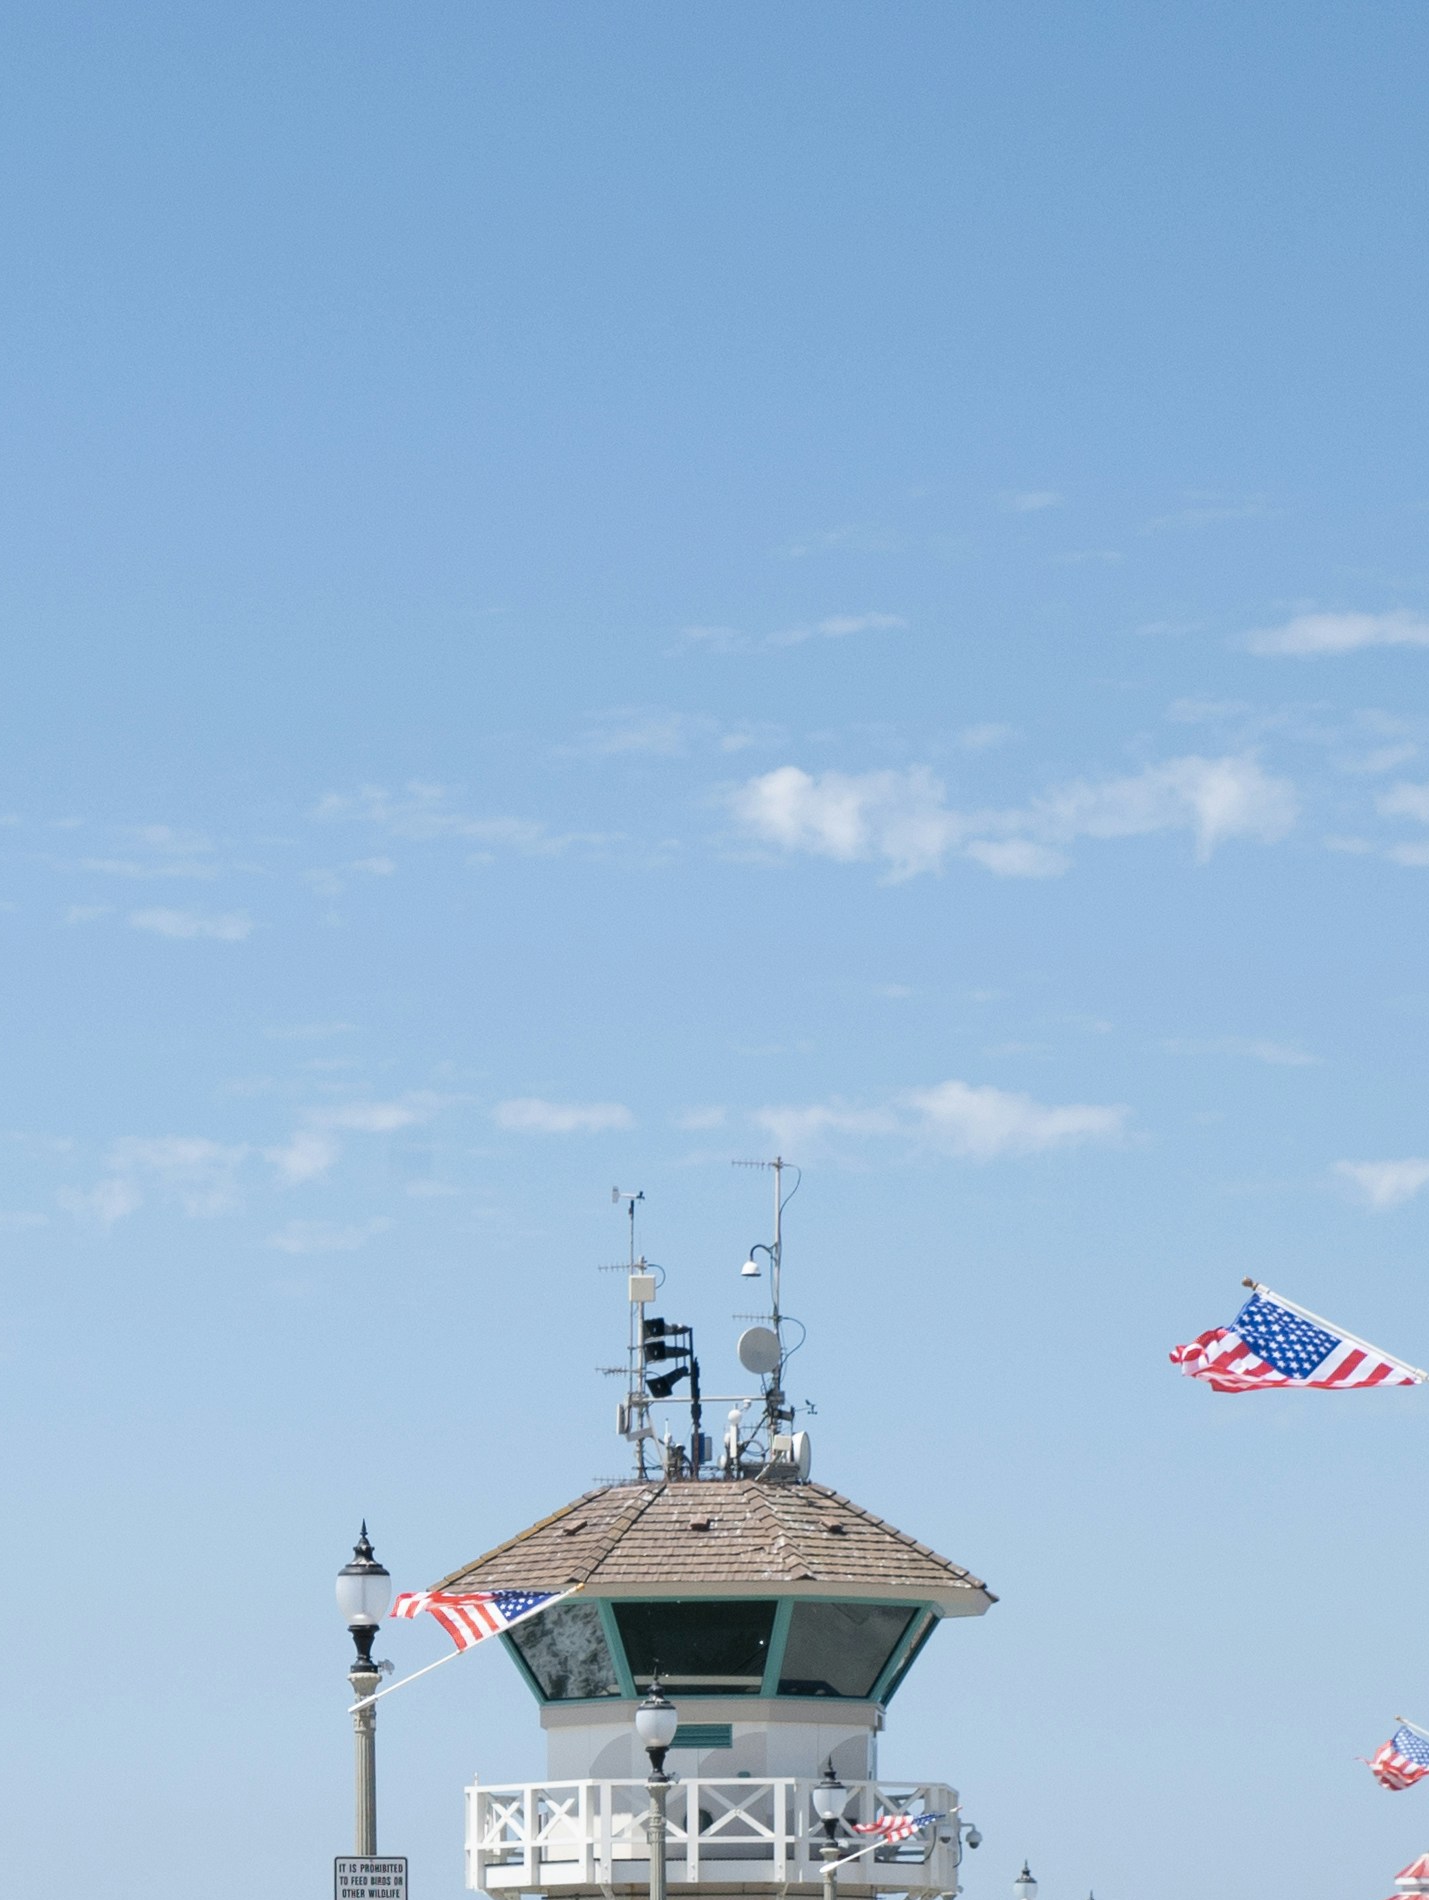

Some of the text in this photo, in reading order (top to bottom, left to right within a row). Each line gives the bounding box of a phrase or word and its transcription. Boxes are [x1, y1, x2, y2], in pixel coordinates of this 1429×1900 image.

[339, 1863, 403, 1873] IT IS PROHIBITED
[339, 1876, 403, 1886] TO FEED BIRDS OR
[342, 1889, 400, 1898] OTHER WILDLIFE
